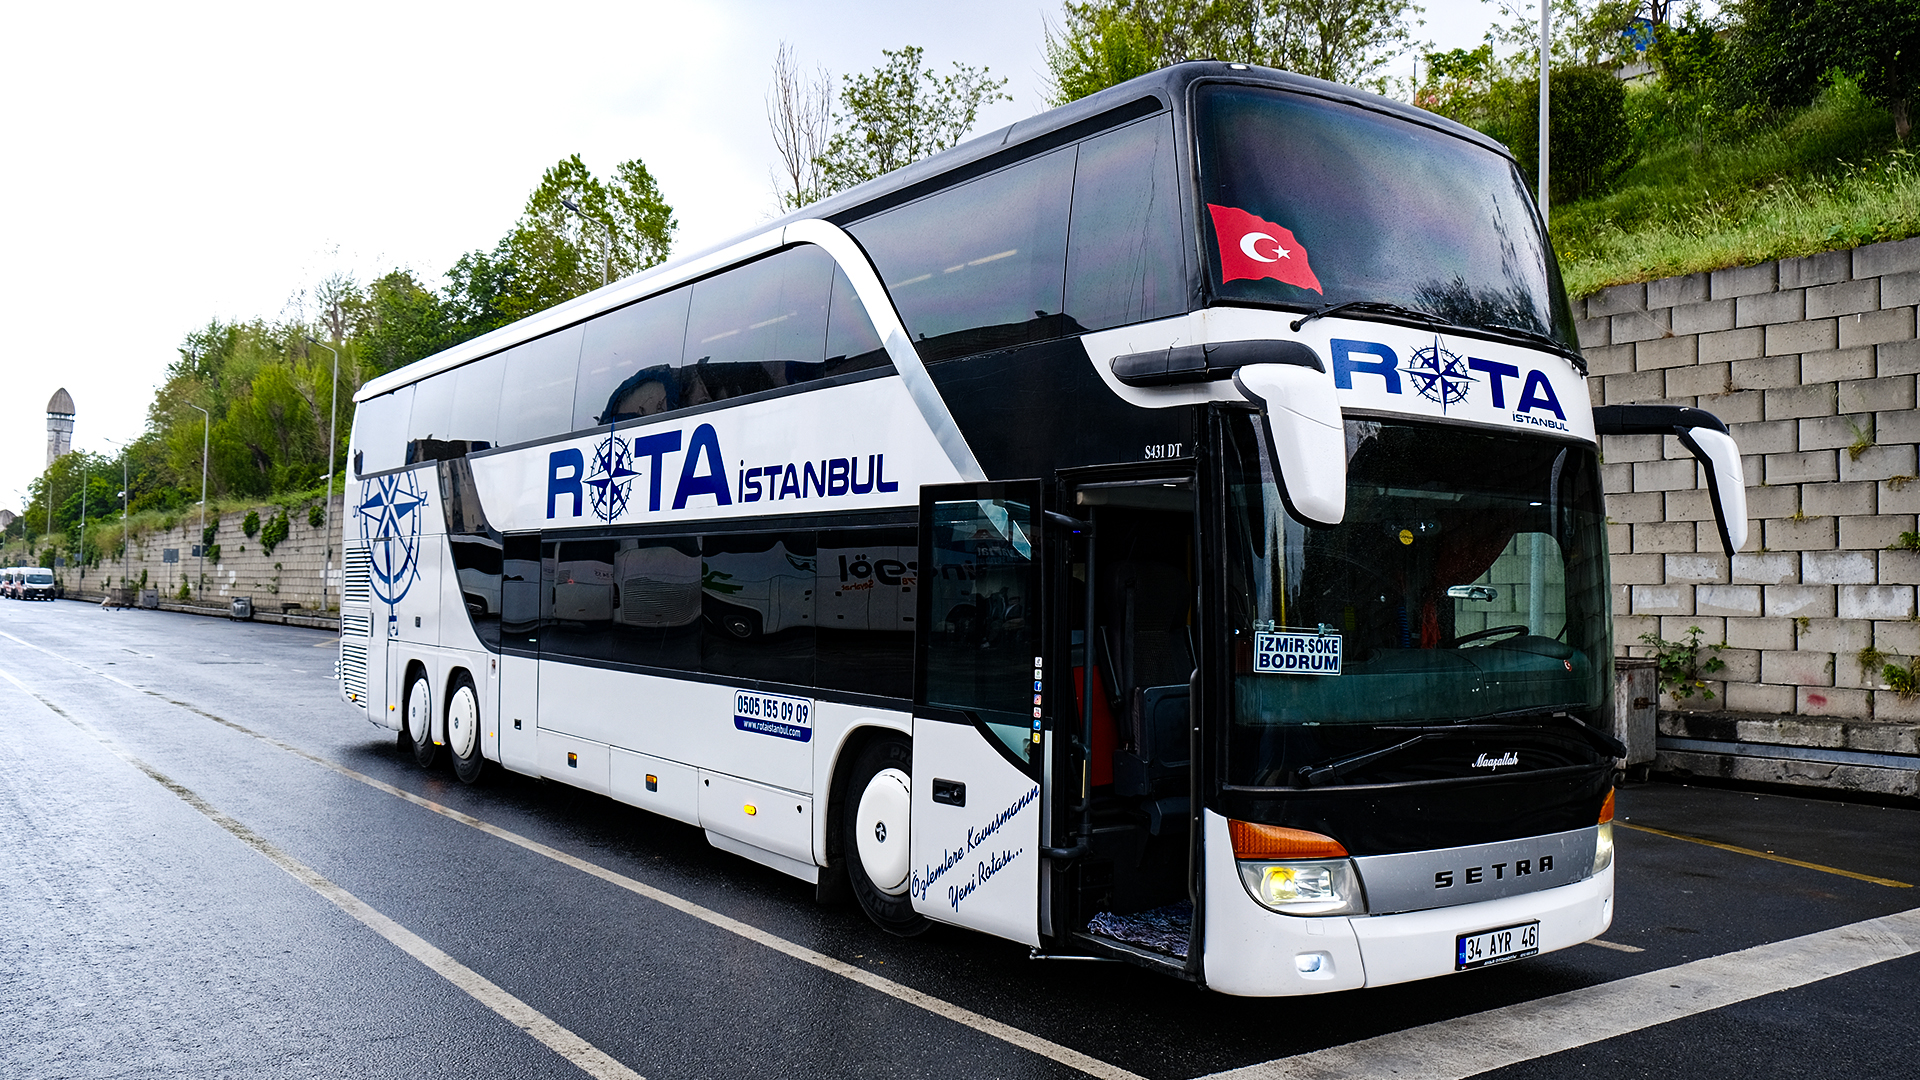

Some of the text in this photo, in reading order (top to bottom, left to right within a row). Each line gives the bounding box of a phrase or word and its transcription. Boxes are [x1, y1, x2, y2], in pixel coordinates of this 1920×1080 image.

[1144, 443, 1183, 459] S431 DT
[738, 453, 899, 504] İSTANBUL
[1259, 653, 1339, 671] BODRUM
[737, 694, 809, 724] 0505 155 09 09
[743, 719, 801, 738] www.rotaistanbul.com
[911, 785, 1040, 901] Özlemlere Kavuşmanın
[1434, 855, 1555, 890] SETRA
[948, 873, 977, 913] Yeni
[1467, 937, 1482, 960] 34
[1489, 931, 1512, 956] AYR
[1521, 925, 1536, 948] 46
